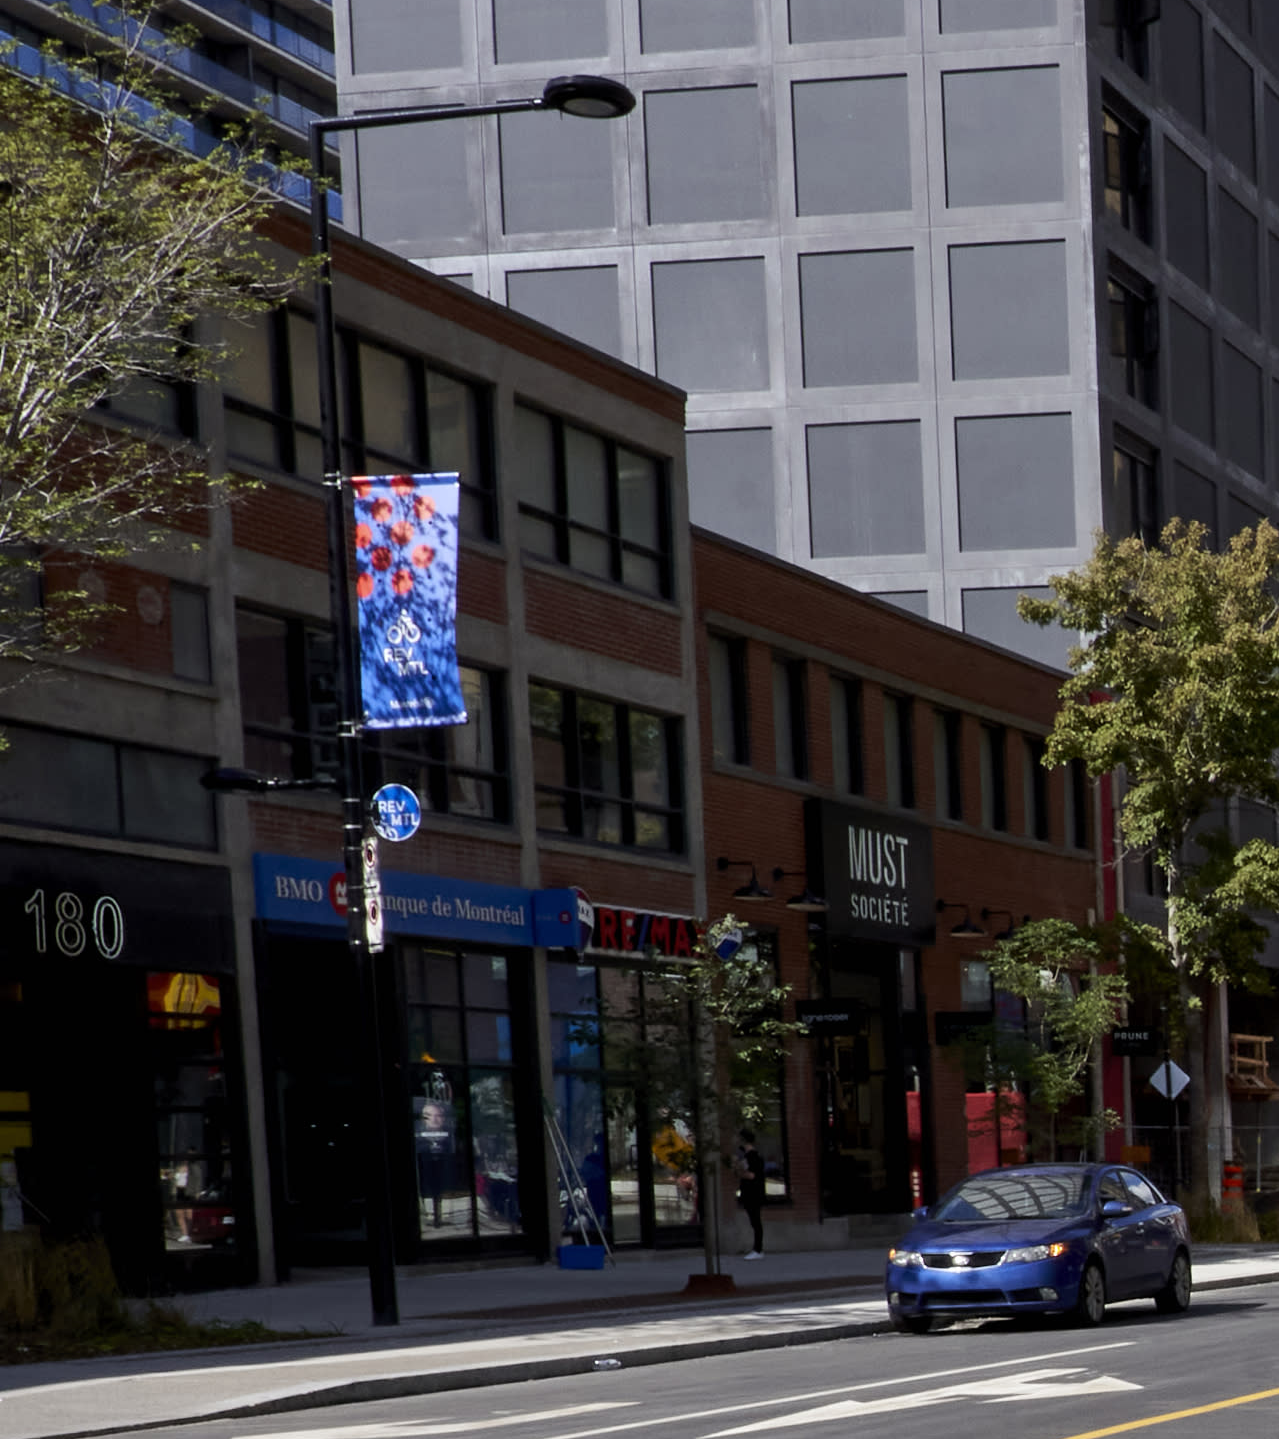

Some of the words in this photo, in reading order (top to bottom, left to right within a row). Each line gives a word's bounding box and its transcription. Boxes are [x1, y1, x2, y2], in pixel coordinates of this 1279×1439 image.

[383, 646, 413, 665] REV
[397, 659, 429, 678] MTL
[378, 800, 406, 814] REV
[391, 813, 419, 827] MTL
[848, 825, 909, 889] MUST
[275, 875, 323, 902] BMO
[383, 894, 428, 919] nque
[431, 895, 451, 917] de
[453, 897, 525, 927] Montréal
[851, 893, 909, 926] SOCIÉTÉ
[24, 888, 124, 959] 180
